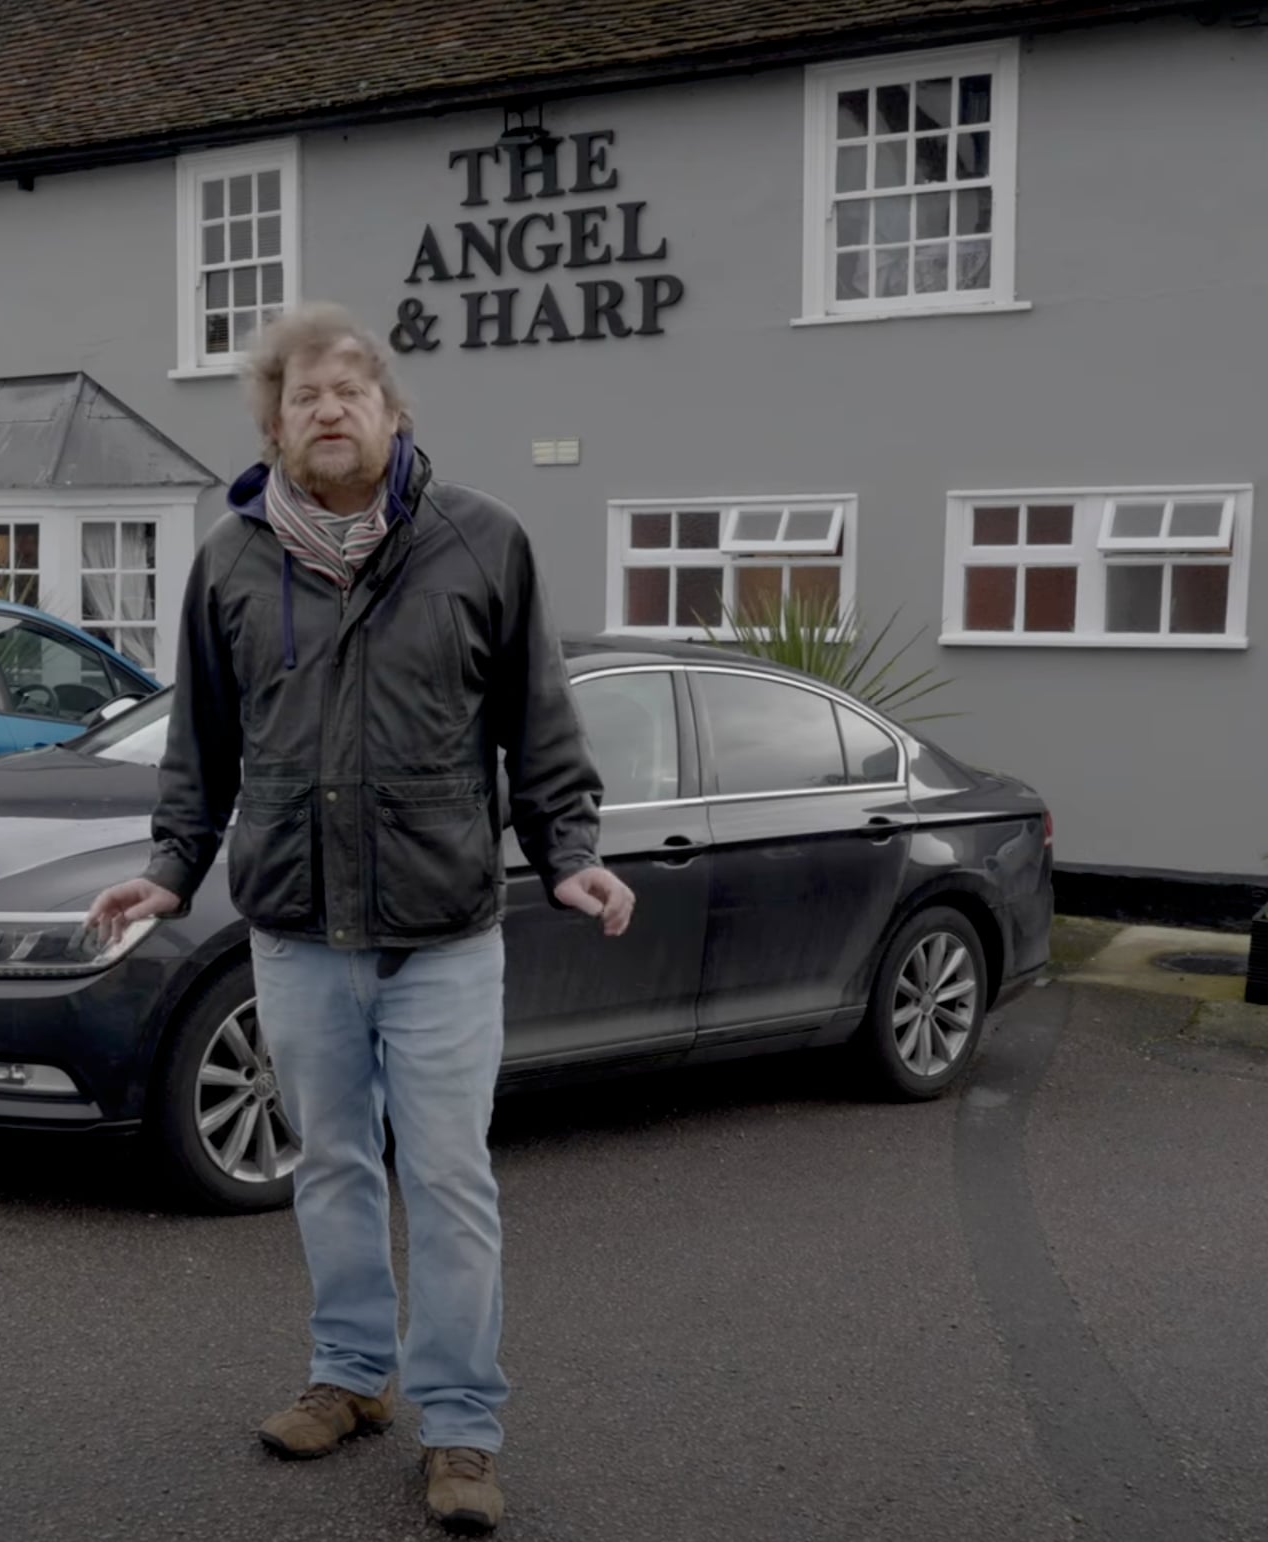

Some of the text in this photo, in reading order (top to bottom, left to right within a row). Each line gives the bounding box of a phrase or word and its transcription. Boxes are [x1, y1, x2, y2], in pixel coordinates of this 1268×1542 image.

[449, 129, 618, 206] THE
[404, 201, 667, 283] ANGEL
[389, 274, 684, 353] & HARP
